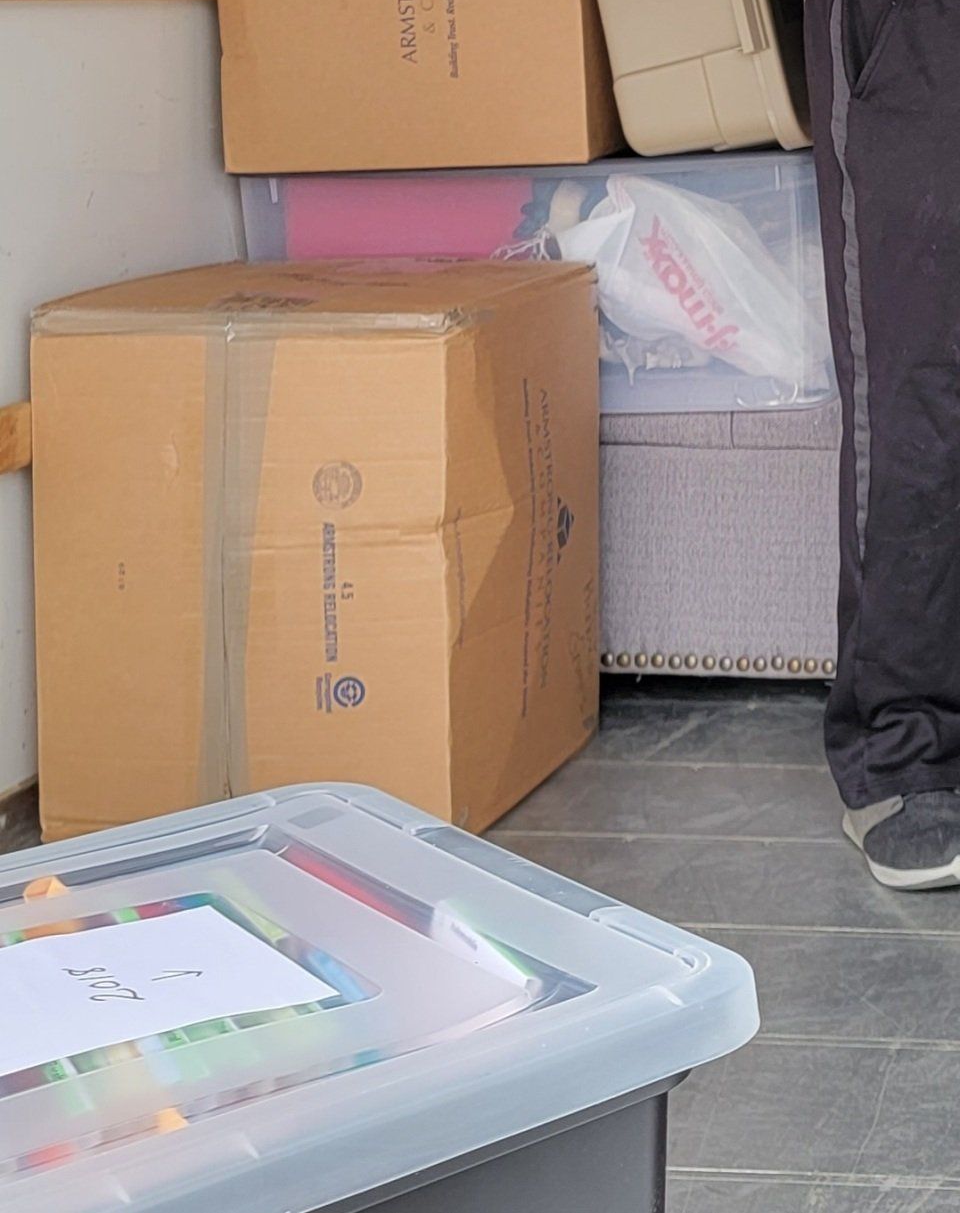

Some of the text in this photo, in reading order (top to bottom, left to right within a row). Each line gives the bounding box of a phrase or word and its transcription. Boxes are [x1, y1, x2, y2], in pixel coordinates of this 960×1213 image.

[423, 22, 436, 35] &
[447, 18, 457, 40] Trust.
[448, 41, 459, 78] Building
[324, 592, 338, 662] RELOCATION
[62, 966, 144, 1003] 2018
